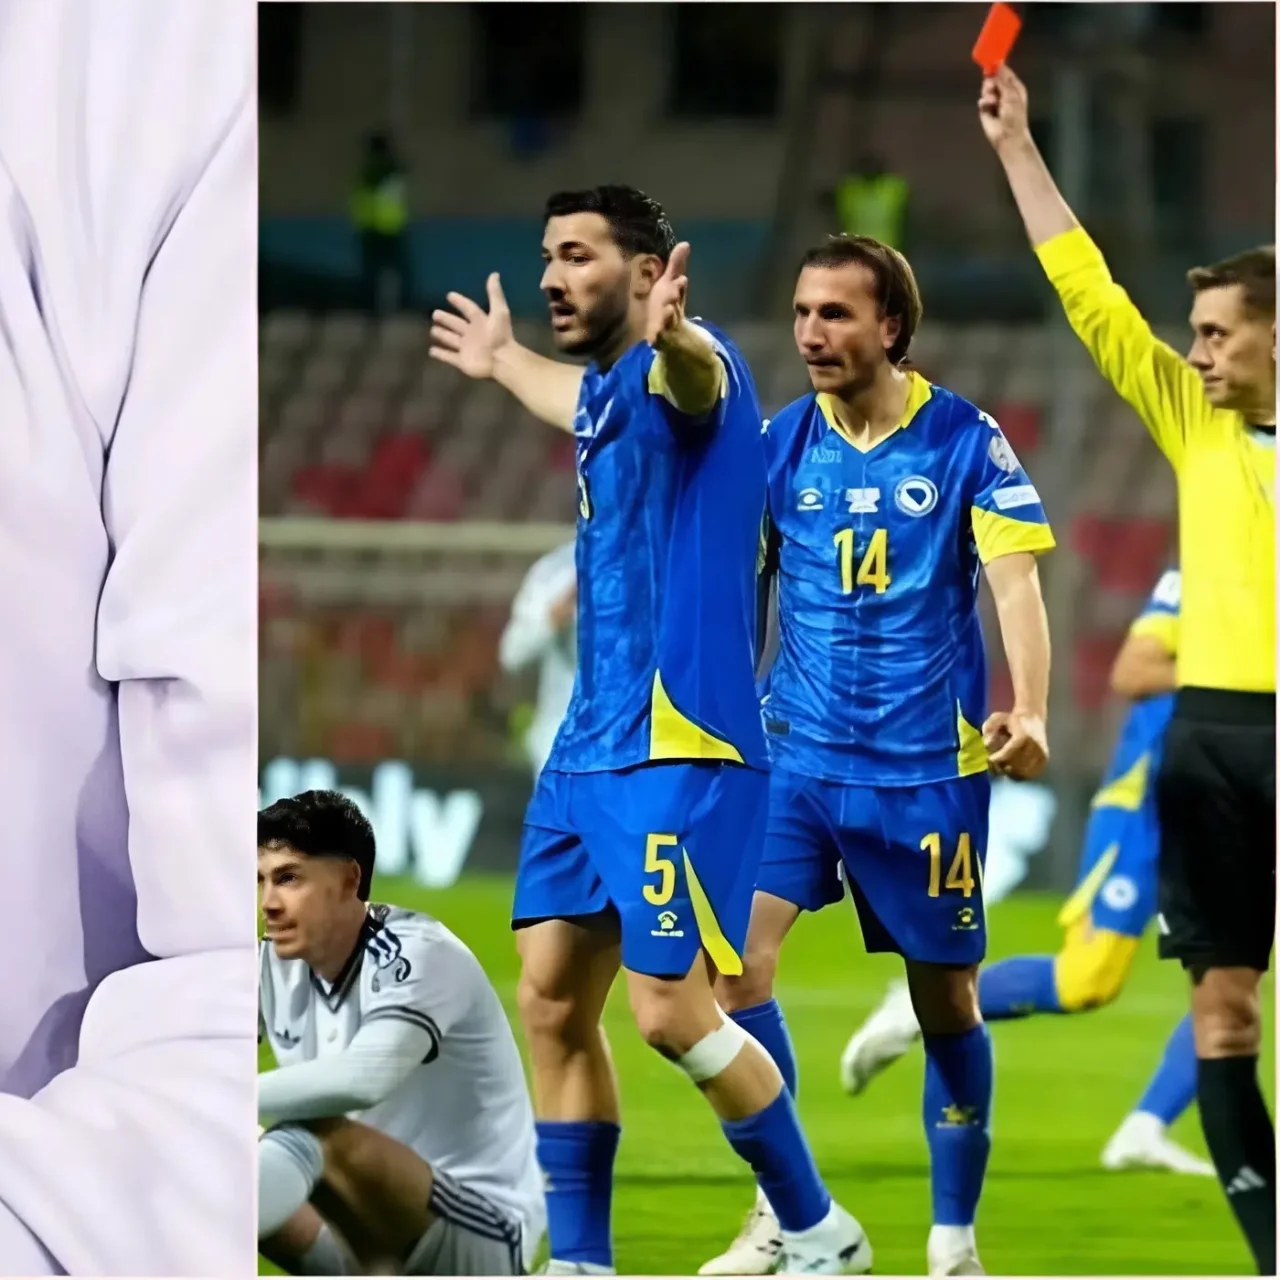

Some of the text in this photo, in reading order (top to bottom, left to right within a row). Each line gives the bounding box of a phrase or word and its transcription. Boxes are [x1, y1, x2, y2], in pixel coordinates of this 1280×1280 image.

[833, 527, 891, 595] 14
[641, 832, 678, 906] 5
[920, 831, 976, 898] 14
